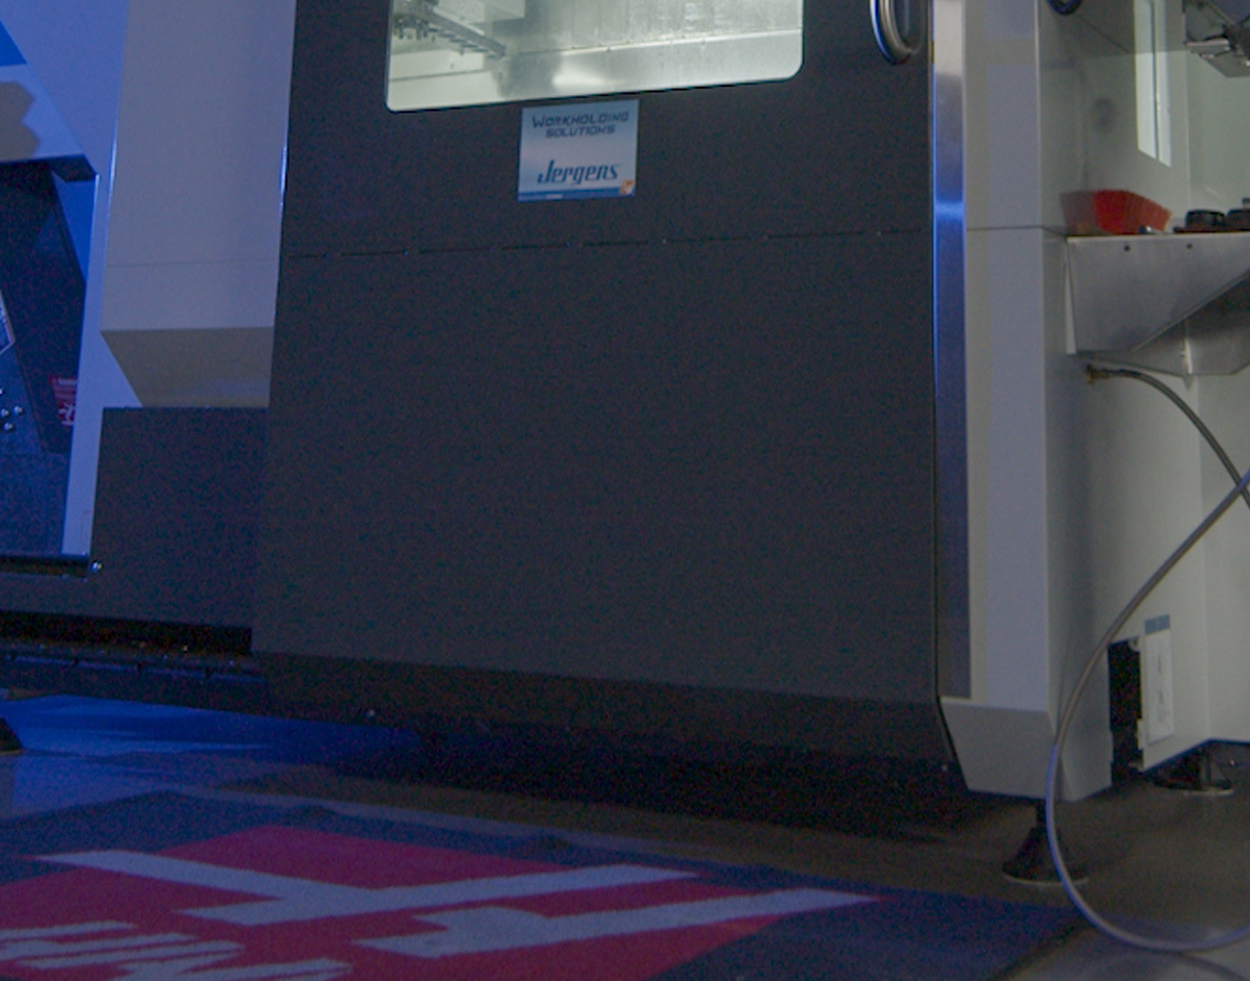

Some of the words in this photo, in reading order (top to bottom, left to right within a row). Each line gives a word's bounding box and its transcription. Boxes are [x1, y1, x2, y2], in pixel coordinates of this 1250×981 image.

[532, 111, 630, 129] WORKHOLDING
[545, 123, 617, 138] SOLUTIONS
[537, 159, 620, 187] Jergens
